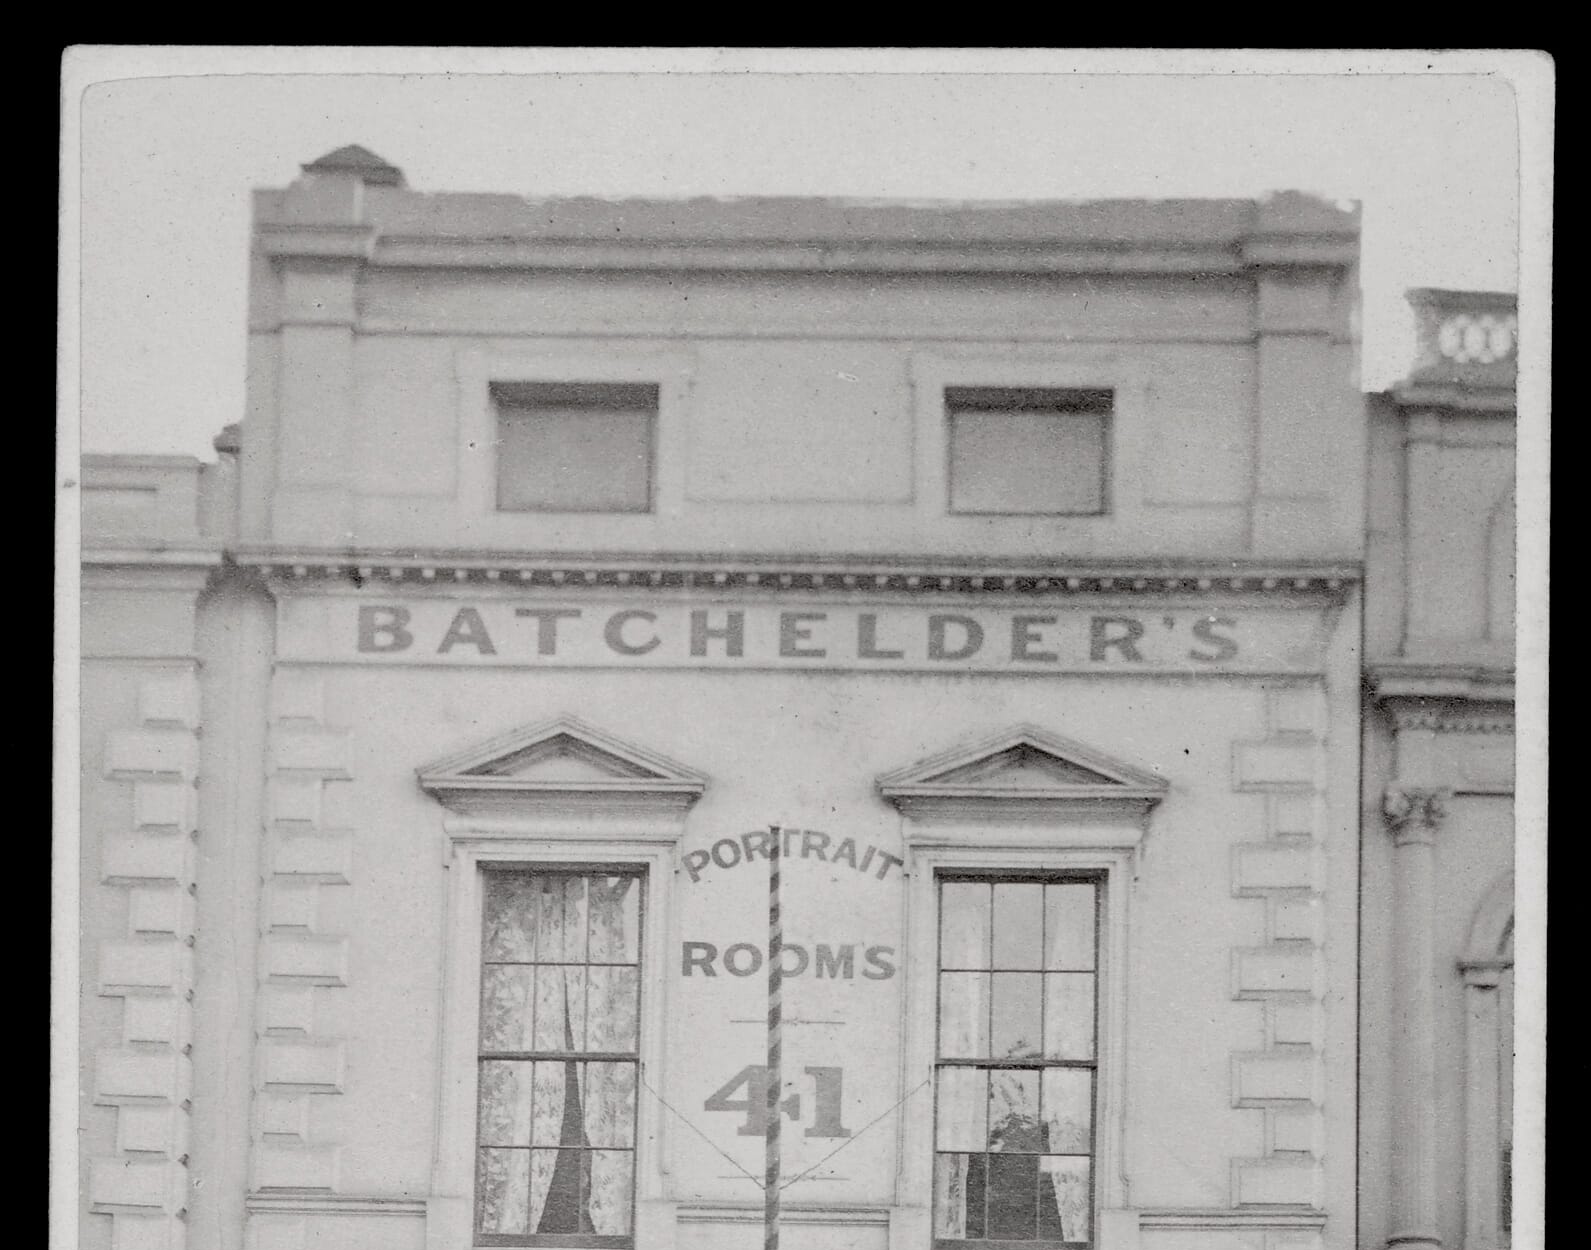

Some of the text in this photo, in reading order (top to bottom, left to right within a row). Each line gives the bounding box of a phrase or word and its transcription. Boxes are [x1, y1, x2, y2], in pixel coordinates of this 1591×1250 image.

[356, 605, 1240, 664] BATCHELDER'S
[681, 828, 904, 883] PORTRAIT
[681, 941, 897, 981] ROOMS
[703, 1064, 851, 1138] 41
